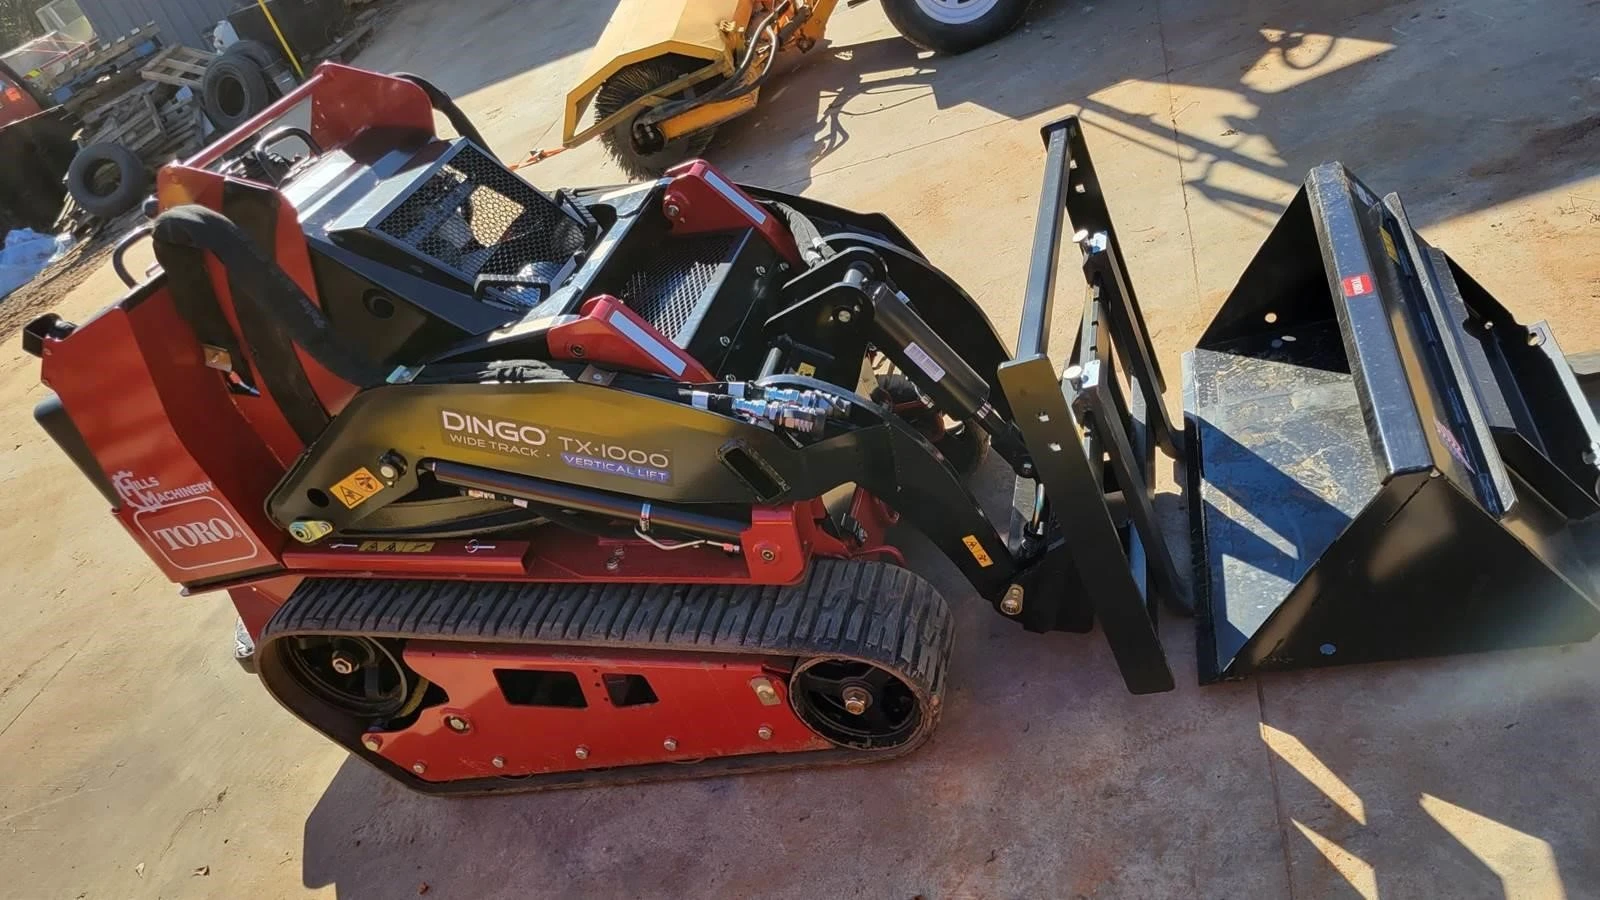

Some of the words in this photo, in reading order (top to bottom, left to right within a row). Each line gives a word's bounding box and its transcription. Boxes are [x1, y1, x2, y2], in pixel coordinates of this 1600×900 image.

[441, 410, 546, 446] DINGO
[450, 433, 486, 449] WIDE
[488, 440, 538, 457] TRACK
[564, 455, 633, 475] VERTICAL
[637, 468, 667, 481] LIFT
[120, 476, 160, 497] HILLS
[137, 481, 214, 511] MACHINERY
[153, 518, 234, 550] TORO
